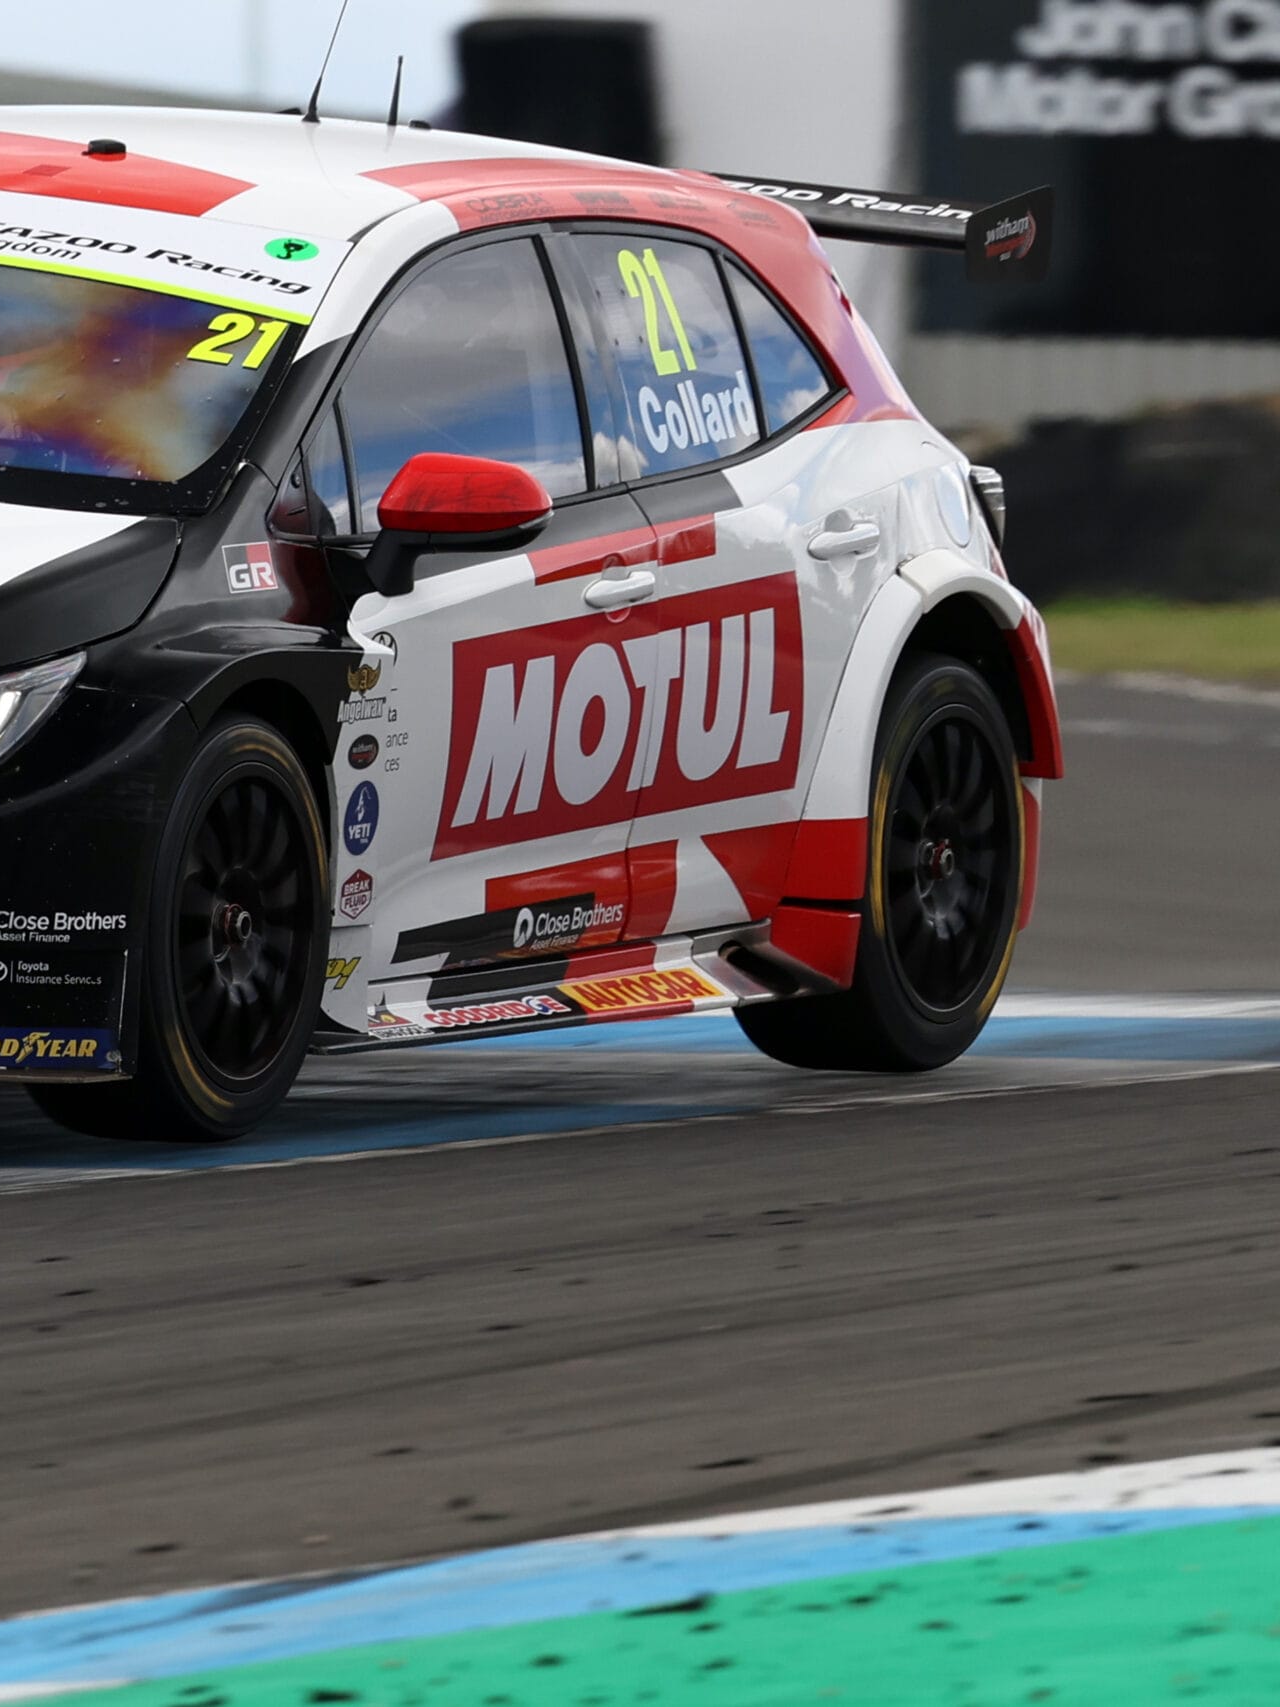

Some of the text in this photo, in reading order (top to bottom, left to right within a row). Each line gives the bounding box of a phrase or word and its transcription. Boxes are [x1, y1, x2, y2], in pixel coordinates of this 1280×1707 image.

[957, 60, 1160, 135] Motor
[827, 192, 973, 222] Racin
[144, 248, 313, 296] Racing
[617, 247, 698, 377] 21
[186, 311, 290, 370] 21
[637, 369, 760, 454] Collard
[229, 561, 276, 590] GR
[449, 606, 791, 828] MOTUL
[348, 823, 372, 840] YETI
[343, 879, 370, 896] BREAK
[343, 894, 367, 910] FLUID
[53, 911, 127, 931] Brothers
[535, 902, 624, 937] Close Brothers
[29, 932, 71, 944] Finance
[15, 974, 63, 985] Insurance
[17, 960, 50, 972] Toyota
[572, 969, 715, 1009] AUTOCAR
[423, 994, 572, 1028] GOODRIDGE
